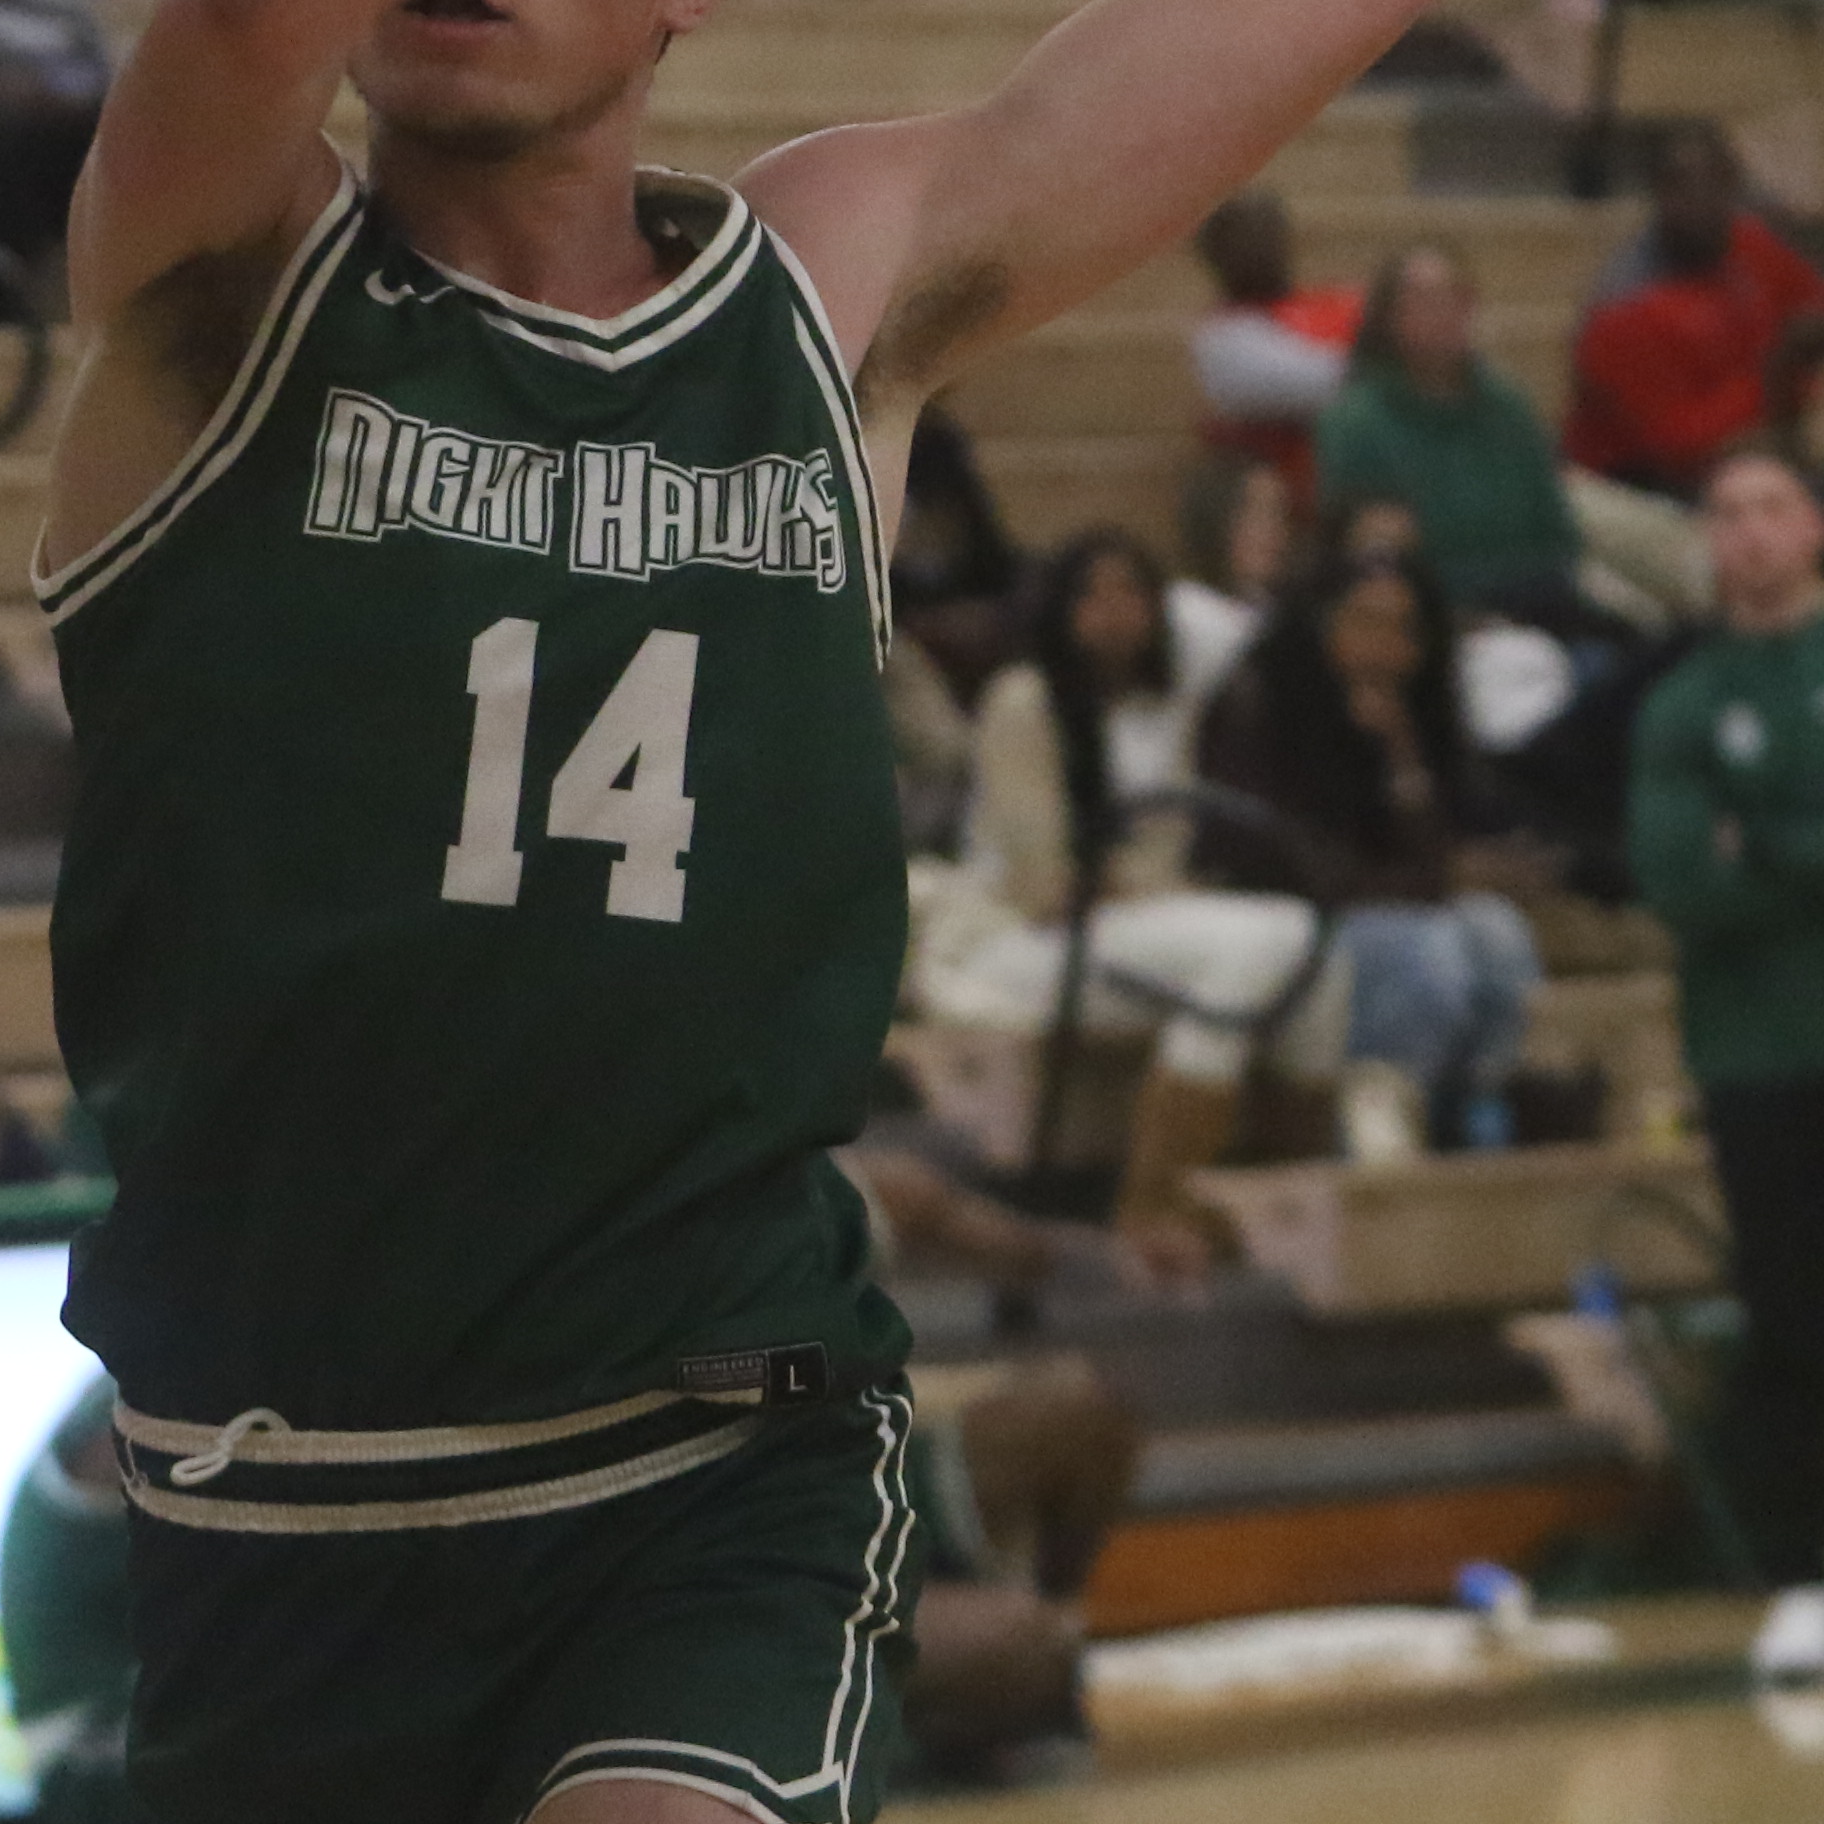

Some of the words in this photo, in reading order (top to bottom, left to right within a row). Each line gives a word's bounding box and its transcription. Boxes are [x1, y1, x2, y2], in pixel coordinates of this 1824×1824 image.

[304, 387, 564, 555] NIGHT
[569, 441, 846, 594] HAWKS
[441, 616, 700, 923] 14
[789, 1364, 808, 1392] L
